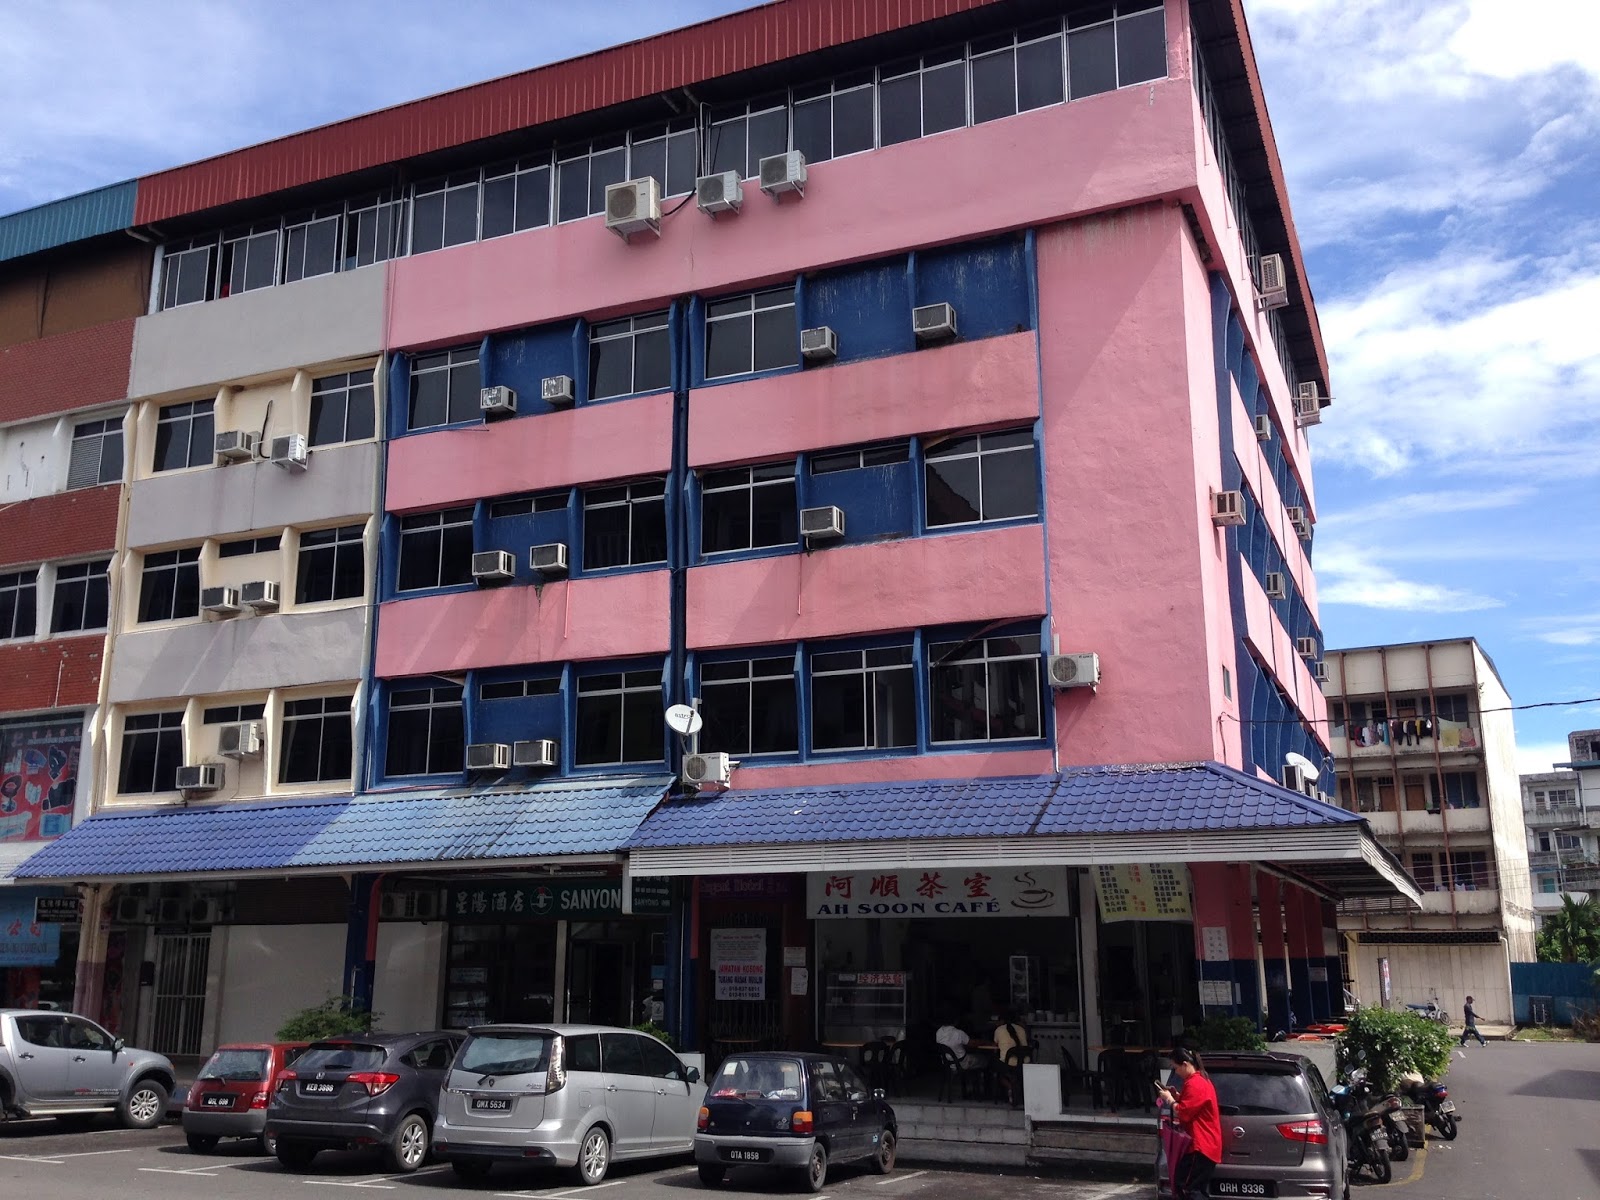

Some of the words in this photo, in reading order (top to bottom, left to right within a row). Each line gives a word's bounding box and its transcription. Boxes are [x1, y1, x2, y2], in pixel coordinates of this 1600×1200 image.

[825, 872, 993, 899] 阿順茶室
[455, 889, 525, 914] 星陽酒店
[560, 888, 622, 910] SANYON
[817, 904, 849, 915] AH
[857, 902, 926, 915] SOON
[934, 898, 1001, 914] CAFÉ
[731, 1150, 742, 1159] QTA
[744, 1151, 759, 1160] 1858
[1219, 1182, 1239, 1193] QRH
[1241, 1183, 1265, 1194] 9336
